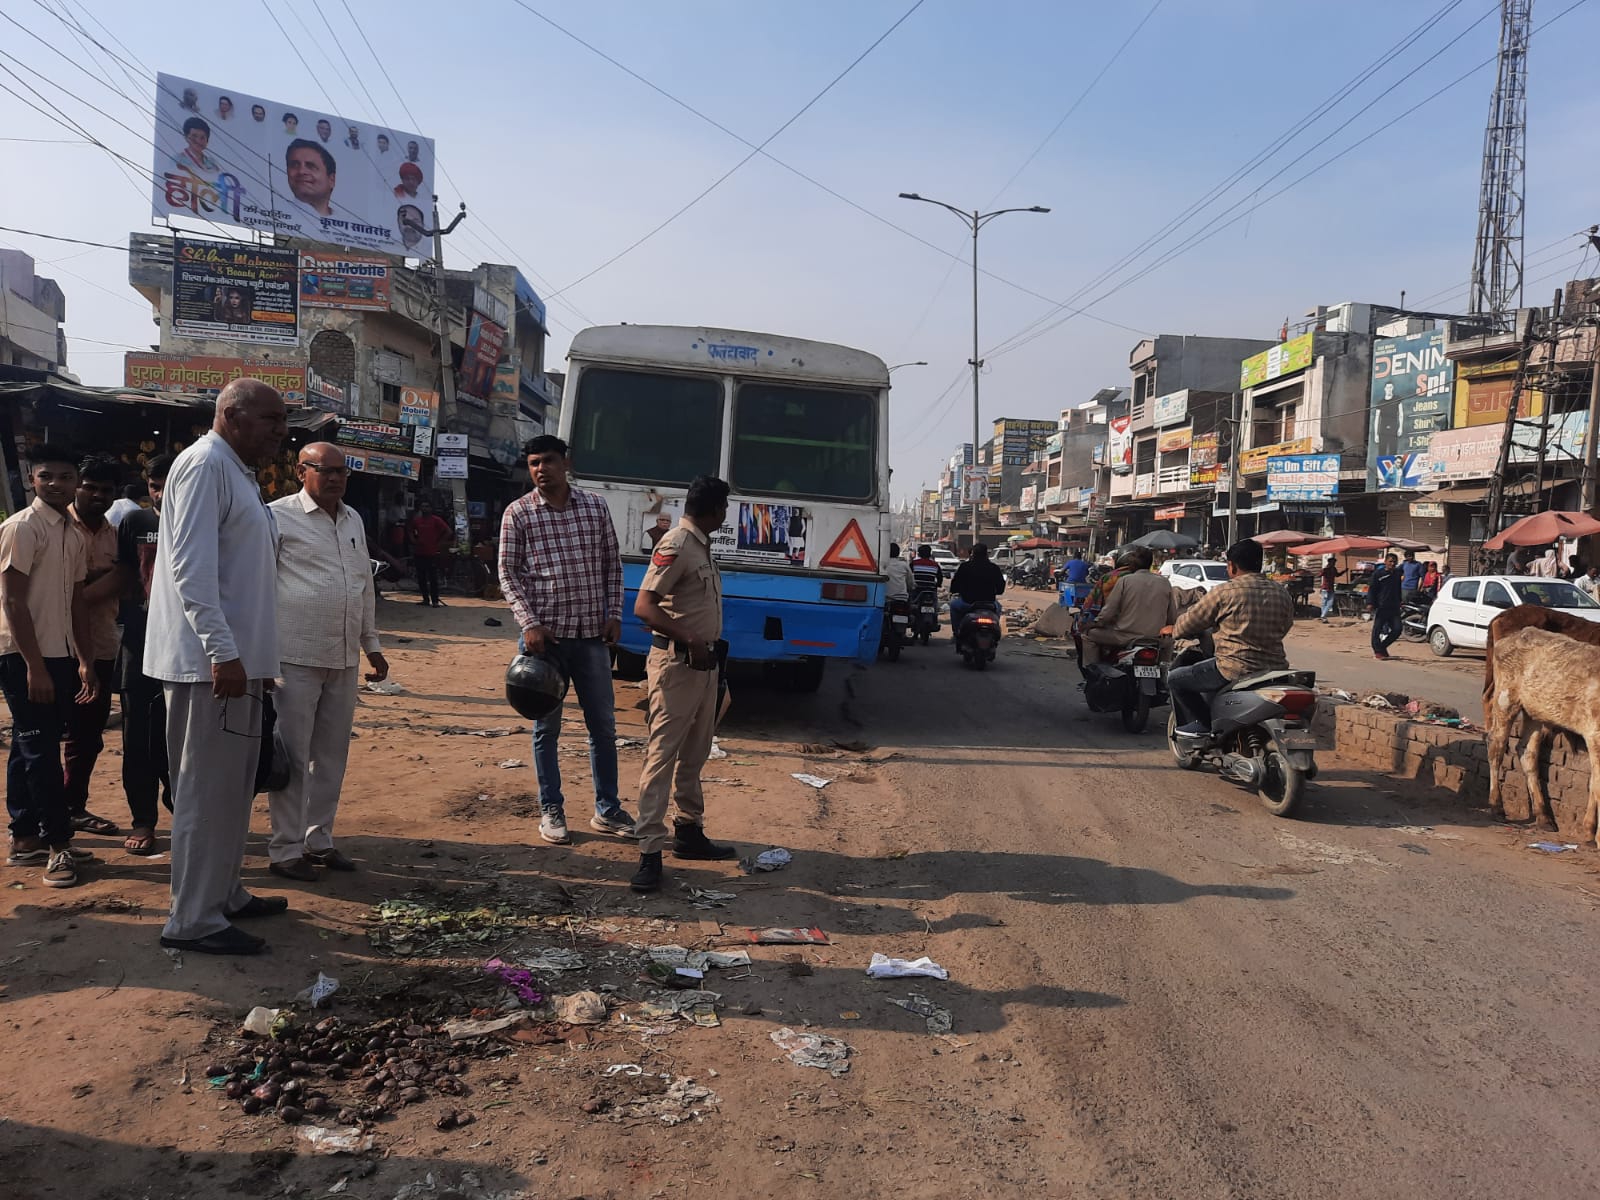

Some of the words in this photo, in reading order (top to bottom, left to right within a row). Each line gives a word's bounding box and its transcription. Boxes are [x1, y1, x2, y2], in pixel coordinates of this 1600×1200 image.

[163, 164, 248, 223] होली
[320, 216, 349, 230] कृष्ण
[337, 262, 385, 277] Mobile
[1375, 347, 1451, 379] DENIM
[130, 362, 167, 387] पुराने
[169, 363, 225, 385] मोबाईल
[307, 366, 322, 391] Om
[1416, 371, 1450, 397] Spl.
[401, 406, 429, 415] Mobile
[1413, 400, 1438, 412] Jeans
[346, 455, 363, 470] ile
[1284, 460, 1300, 472] Om
[1303, 459, 1321, 472] Gift
[1268, 473, 1305, 485] Plastic
[1307, 472, 1337, 484] Store
